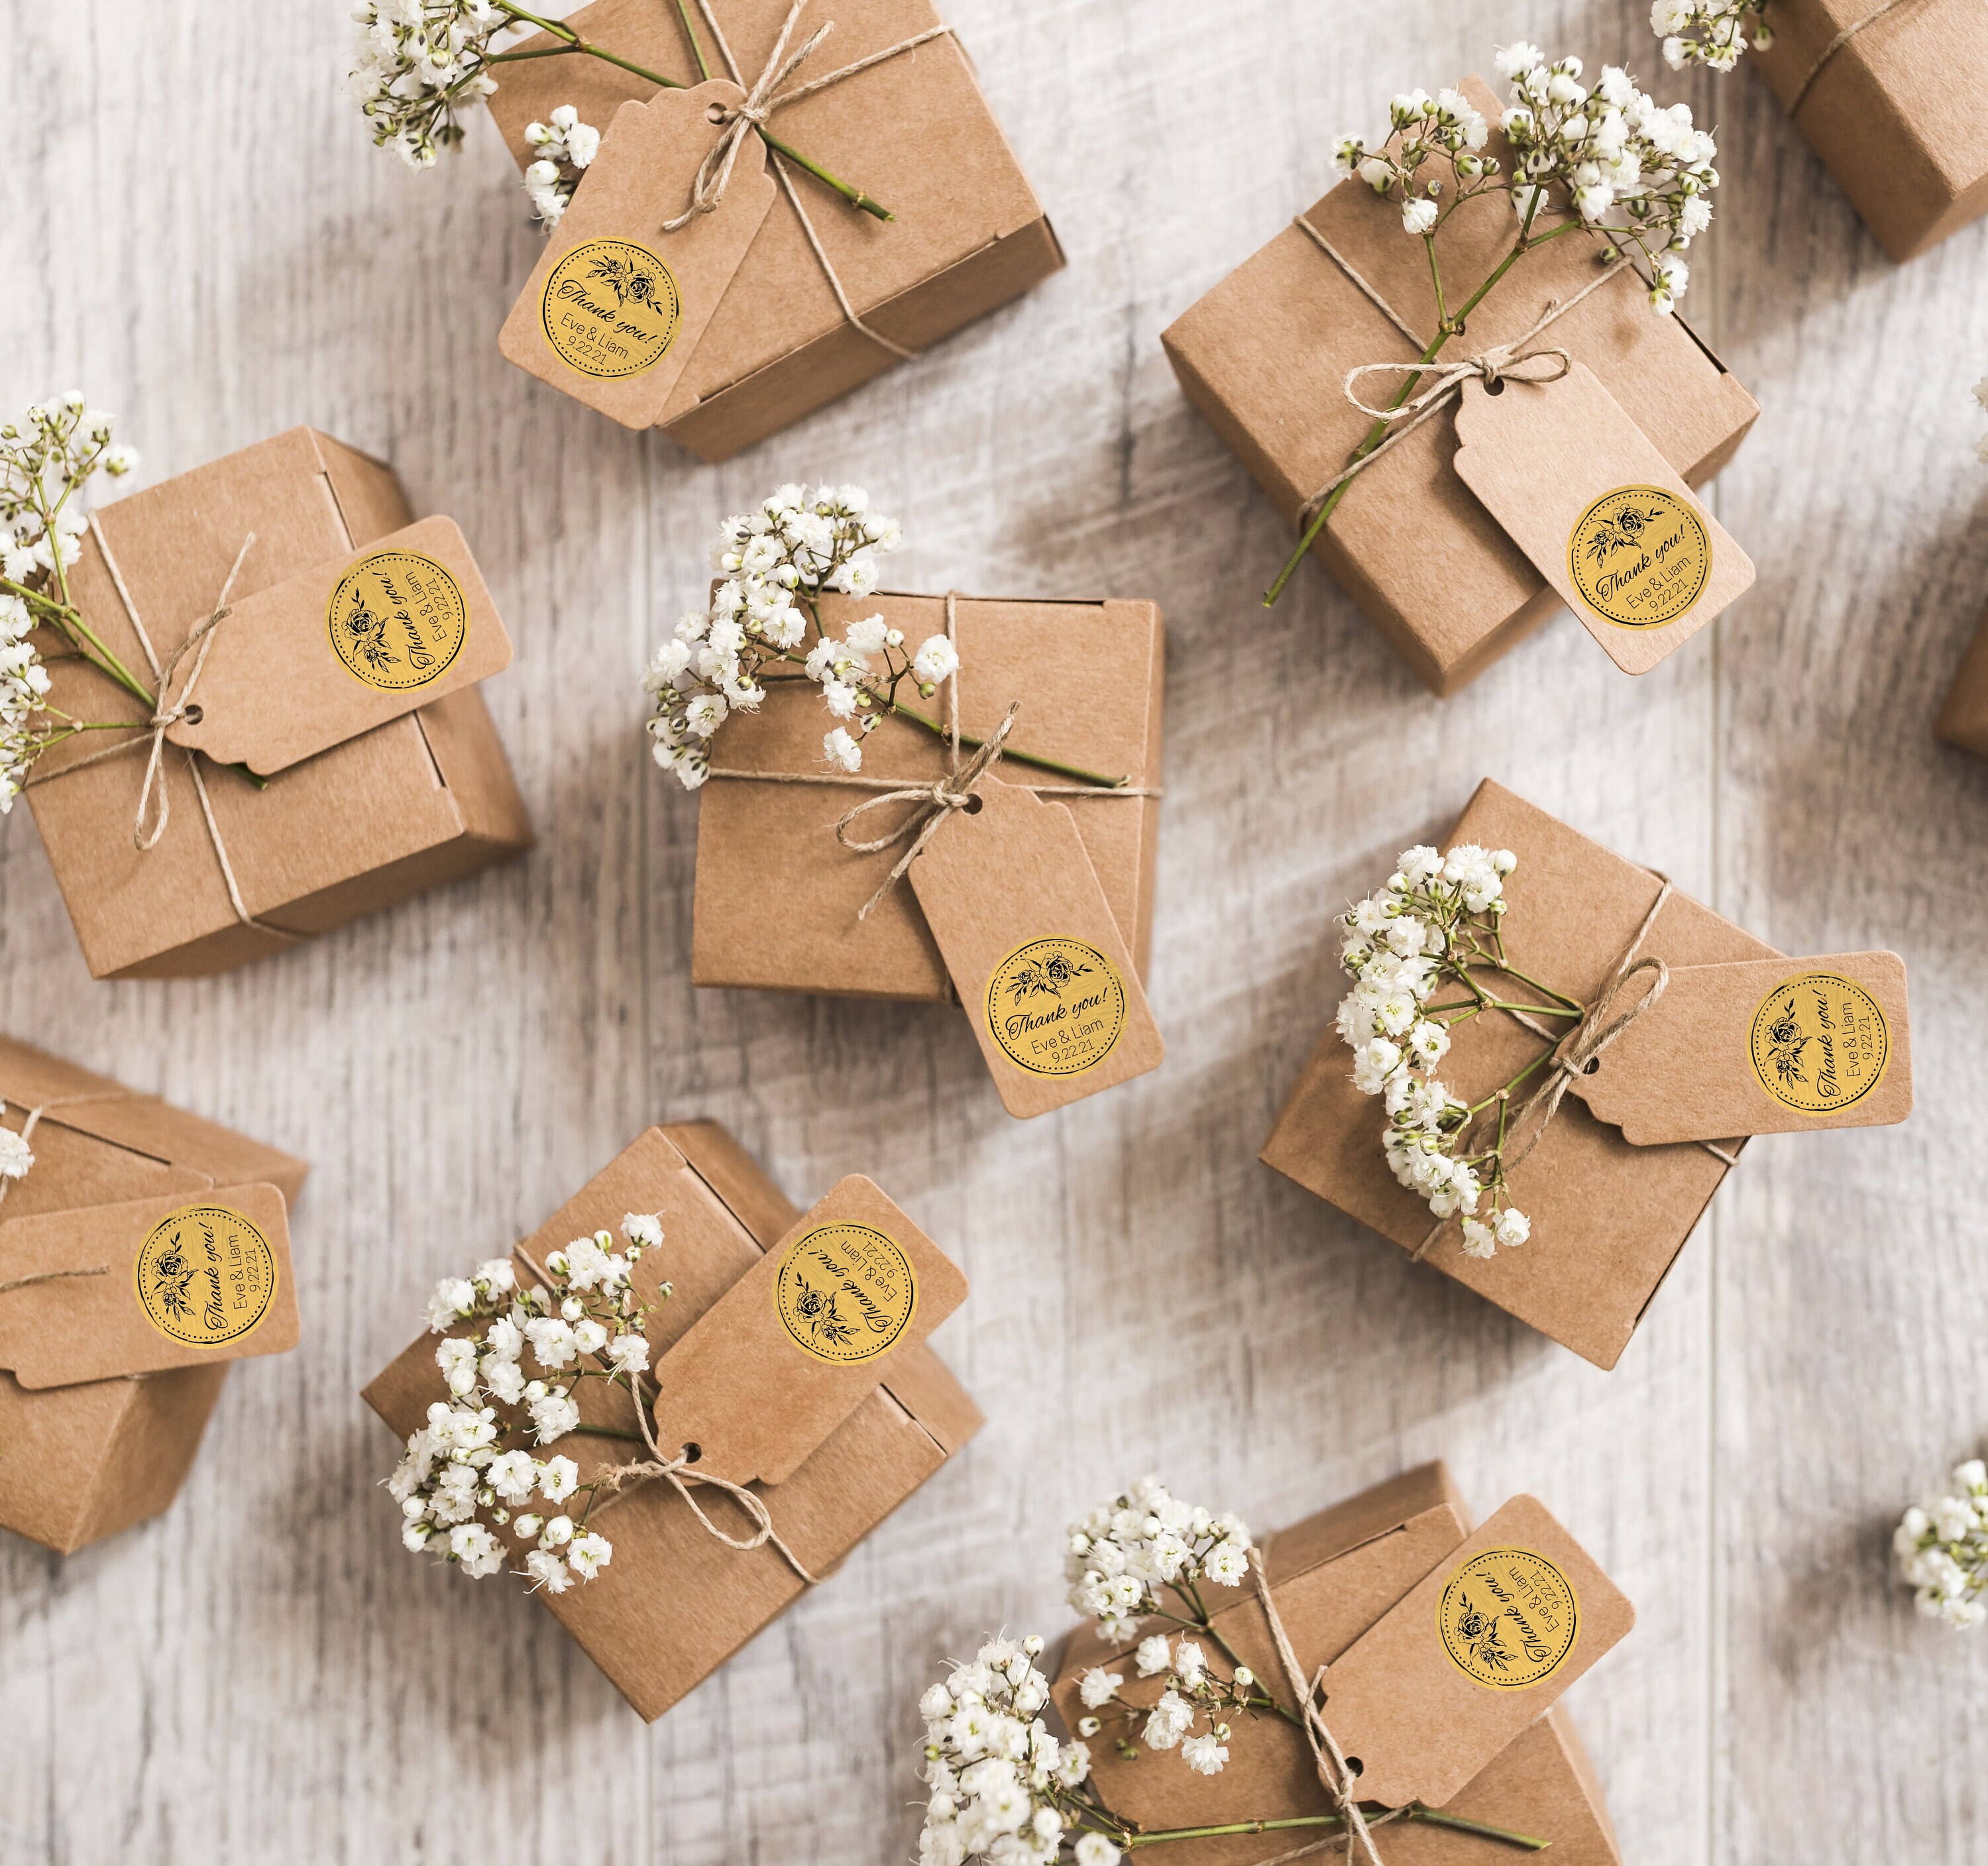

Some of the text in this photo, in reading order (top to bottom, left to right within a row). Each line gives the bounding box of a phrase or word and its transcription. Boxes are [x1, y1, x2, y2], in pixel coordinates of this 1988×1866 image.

[557, 279, 658, 344] Thank you!
[561, 312, 628, 360] Eve & Liam
[566, 335, 606, 366] 9.22.21
[1596, 523, 1685, 602] Thank you!
[1626, 557, 1691, 609] Eve & Liam
[372, 572, 435, 670] Thank you!
[406, 571, 447, 642] Eve & Liam
[425, 577, 454, 620] 9.22.21
[1649, 578, 1689, 612] 9.22.21
[1005, 987, 1107, 1040] Thank you!
[1030, 1020, 1104, 1055] Eve & Liam
[1842, 1003, 1861, 1077] Eve & Liam
[1858, 1016, 1874, 1060] 9.22.21
[1052, 1039, 1095, 1064] 9.22.21
[1812, 989, 1842, 1098] Thank you!
[198, 1222, 229, 1331] Thank you!
[228, 1235, 248, 1309] Eve & Liam
[245, 1248, 261, 1292] 9.22.21
[841, 1240, 897, 1302] Eve & Liam
[862, 1240, 898, 1278] 9.22.21
[807, 1249, 893, 1333] Thank you!
[1475, 1572, 1552, 1663] Thank you!
[1509, 1566, 1560, 1633] Eve & Liam
[1530, 1569, 1563, 1610] 9.22.21
